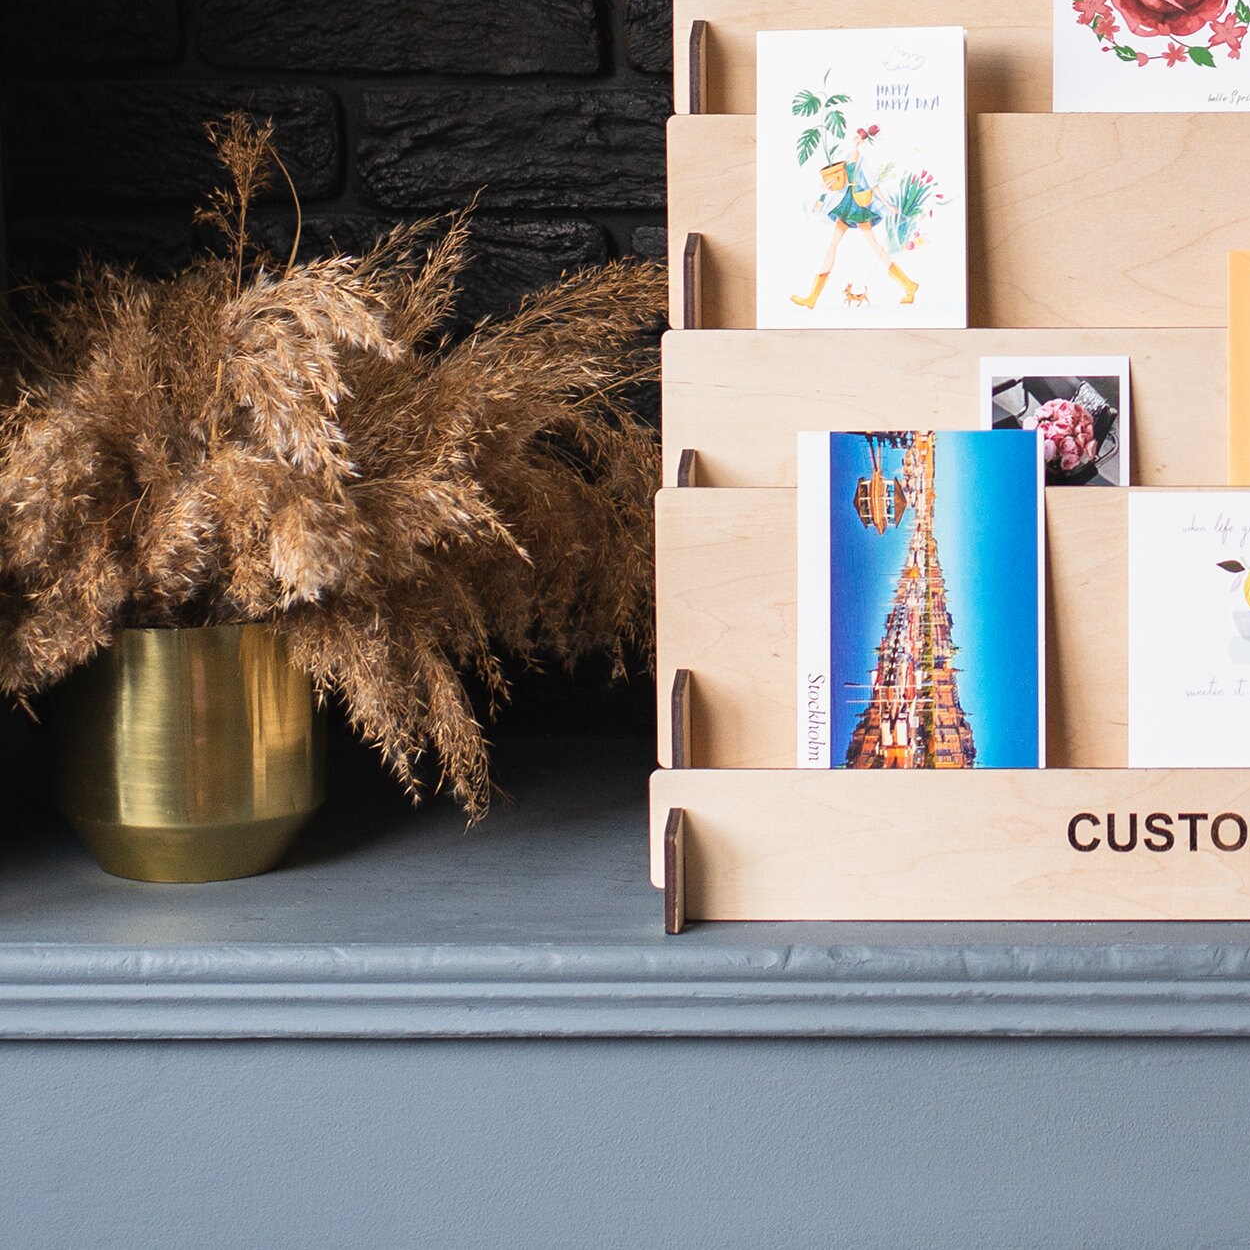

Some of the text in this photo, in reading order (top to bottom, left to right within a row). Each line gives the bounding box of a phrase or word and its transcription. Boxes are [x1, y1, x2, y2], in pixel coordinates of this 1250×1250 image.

[876, 83, 910, 97] HAPPY
[876, 95, 940, 111] HAPPY DAY!
[807, 673, 826, 761] Stockholm
